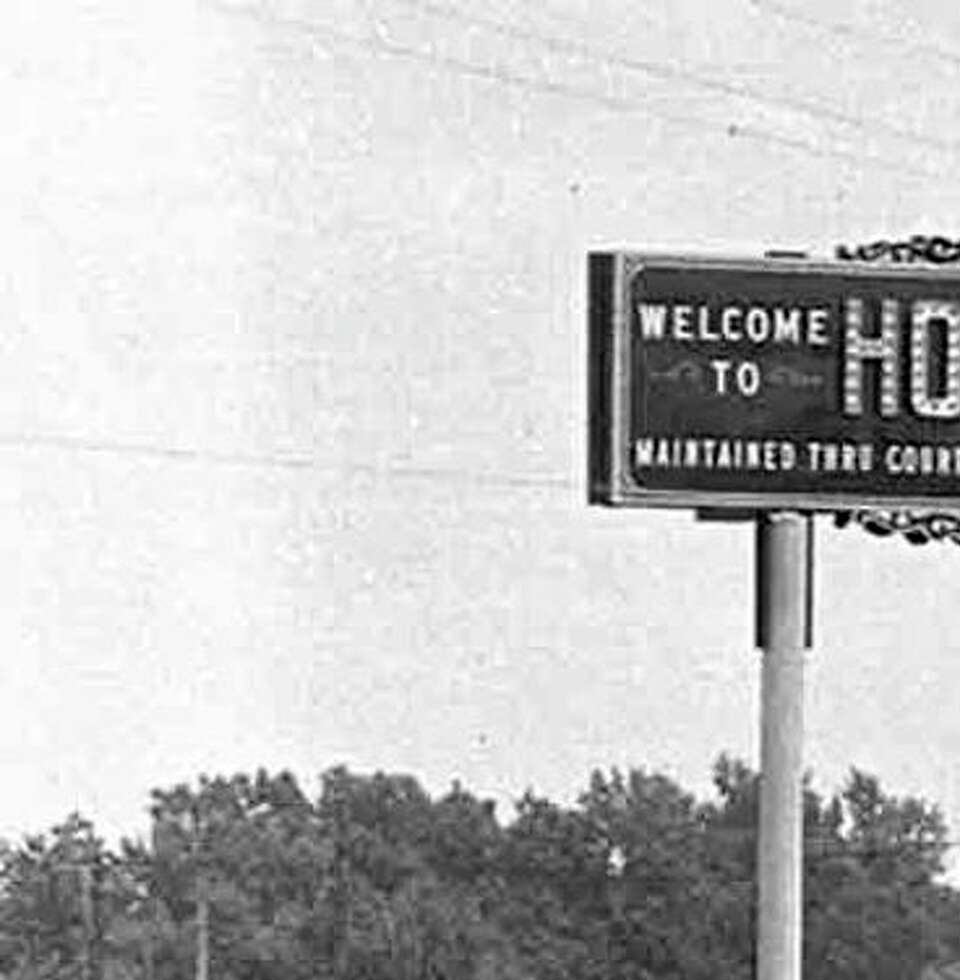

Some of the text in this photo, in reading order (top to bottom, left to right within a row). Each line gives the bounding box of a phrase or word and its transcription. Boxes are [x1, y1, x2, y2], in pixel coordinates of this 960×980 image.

[638, 303, 830, 346] WELCOME
[711, 360, 761, 397] TO
[635, 438, 797, 472] MAINTAINED
[808, 441, 873, 473] THRU
